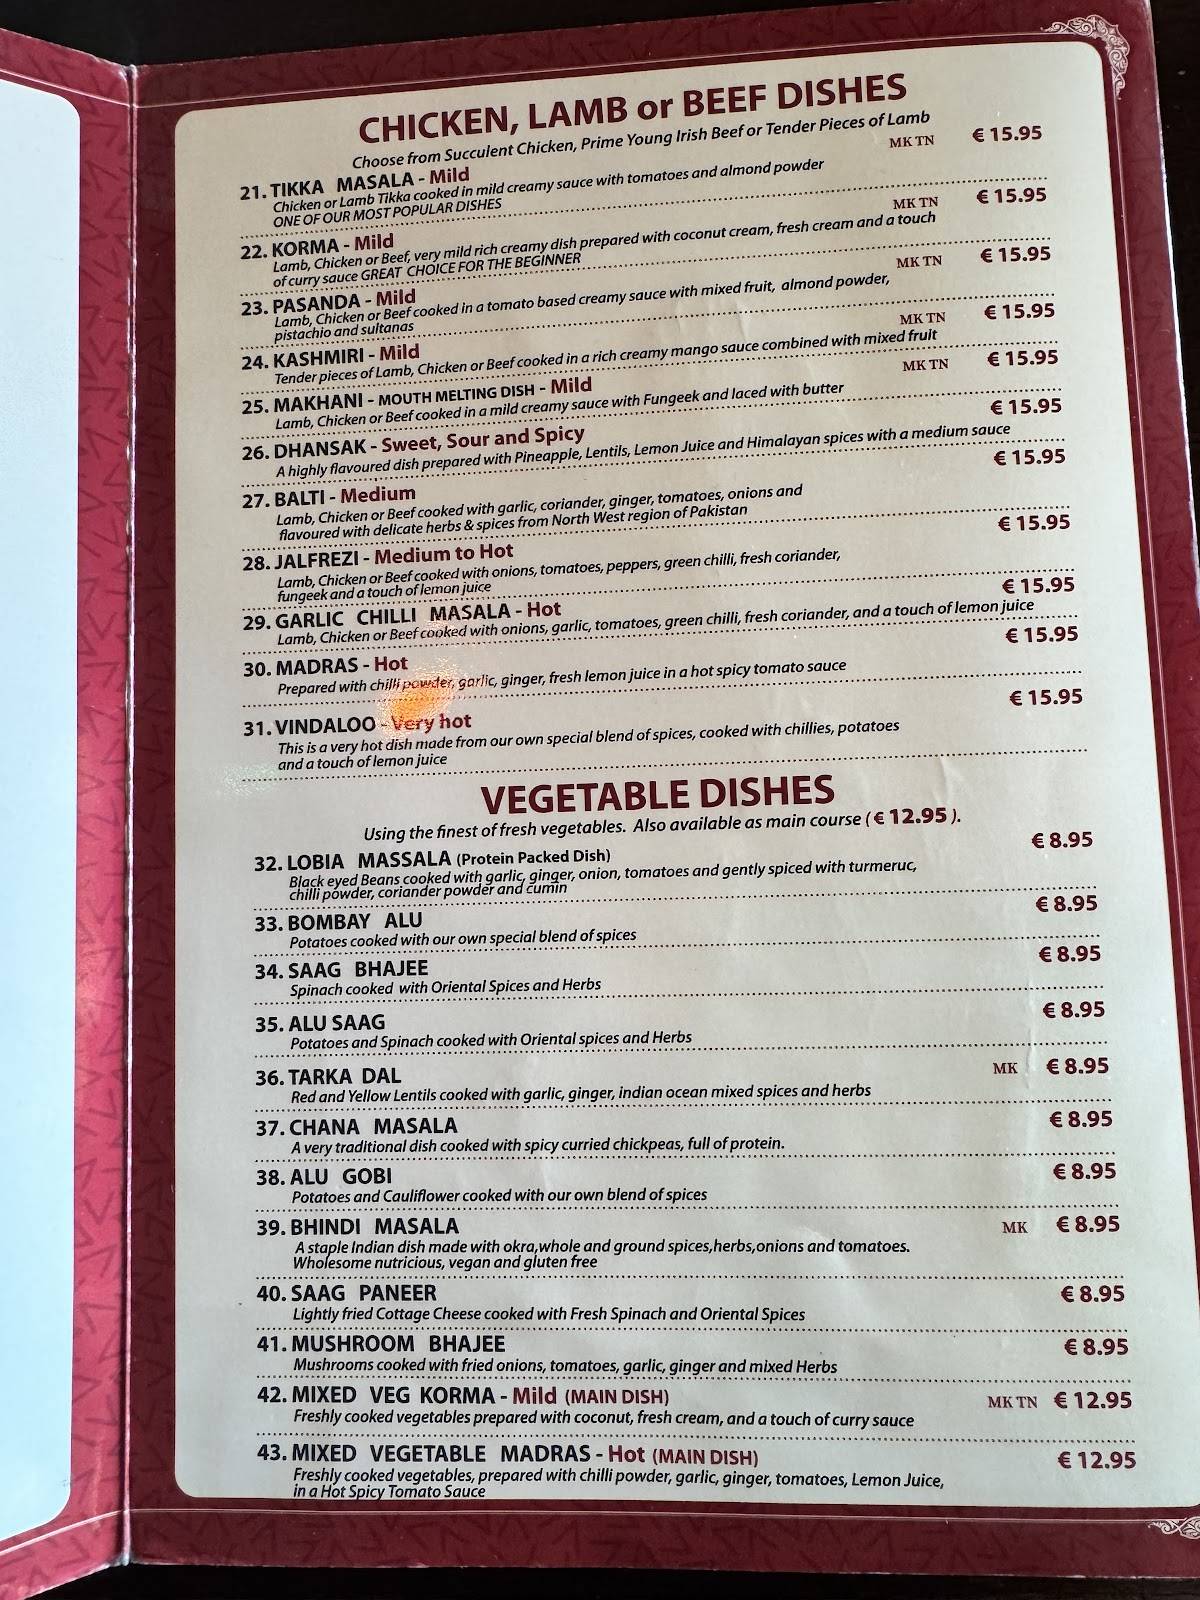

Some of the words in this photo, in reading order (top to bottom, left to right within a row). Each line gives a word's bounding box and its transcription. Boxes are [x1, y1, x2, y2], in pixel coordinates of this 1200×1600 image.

[359, 105, 519, 144] CHICKEN,
[529, 96, 628, 129] LAMB
[637, 98, 674, 120] or
[683, 84, 766, 117] BEEF
[777, 73, 907, 109] DISHES
[352, 155, 404, 169] Choose
[407, 151, 441, 165] from
[444, 144, 514, 162] Succulent
[516, 139, 577, 155] Chicken,
[581, 136, 624, 150] Prime
[627, 133, 673, 147] Young
[676, 127, 708, 143] Irish
[711, 124, 745, 140] Beef
[746, 126, 763, 137] or
[766, 119, 817, 135] Tender
[819, 117, 865, 131] Pieces
[868, 112, 886, 128] of
[887, 110, 930, 126] Lamb
[889, 136, 913, 148] MK
[915, 135, 934, 146] TN
[972, 128, 985, 143] €
[990, 125, 1042, 142] 15.95
[240, 185, 268, 201] 21.
[270, 179, 325, 198] TIKKA
[337, 172, 415, 193] MASALA
[429, 166, 470, 184] Mild
[273, 215, 301, 228] ONE
[303, 213, 321, 226] OF
[322, 210, 351, 224] OUR
[353, 207, 392, 221] MOST
[392, 201, 454, 218] POPULAR
[455, 197, 502, 212] DISHES
[240, 244, 268, 260] 22.
[272, 238, 340, 258] KORMA
[354, 232, 394, 251] Mild
[899, 313, 924, 325] MK
[925, 312, 946, 323] TN
[984, 305, 997, 320] €
[1002, 303, 1055, 319] 15.95
[241, 355, 269, 371] 24.
[273, 347, 364, 369] KASHMIRI
[379, 343, 420, 361] Mild
[242, 445, 270, 461] 26.
[274, 439, 367, 459] DHANSAK
[381, 436, 442, 453] Sweet,
[446, 433, 490, 449] Sour
[494, 427, 530, 446] and
[534, 425, 585, 446] Spicy
[275, 465, 285, 478] A
[288, 463, 328, 480] highly
[330, 459, 391, 475] flavoured
[393, 457, 419, 471] dish
[421, 453, 481, 472] prepared
[483, 451, 512, 465] with
[514, 447, 582, 465] Pineapple,
[585, 444, 631, 459] Lentils,
[634, 443, 679, 456] Lemon
[681, 439, 715, 453] Juice
[717, 436, 745, 450] and
[747, 434, 821, 449] Himalayan
[823, 431, 864, 447] spices
[867, 427, 897, 442] with
[899, 430, 909, 440] a
[911, 425, 968, 439] medium
[971, 425, 1011, 436] sauce
[242, 555, 271, 571] 28.
[274, 550, 359, 570] JALFREZI
[374, 547, 451, 565] Medium
[455, 546, 475, 561] to
[480, 543, 514, 559] Hot
[1002, 578, 1015, 594] €
[1020, 576, 1075, 594] 15.95
[243, 615, 271, 631] 29.
[275, 611, 344, 629] GARLIC
[356, 607, 416, 626] CHILLI
[430, 603, 511, 622] MASALA
[527, 601, 562, 618] Hot
[480, 779, 690, 815] VEGETABLE
[700, 774, 835, 808] DISHES
[1031, 832, 1045, 849] €
[1049, 831, 1093, 849] 8.95
[254, 856, 283, 872] 32.
[287, 853, 345, 871] LOBIA
[358, 850, 452, 869] MASSALA
[457, 852, 514, 868] (Protein
[518, 849, 570, 864] Packed
[573, 848, 611, 863] Dish)
[254, 916, 283, 932] 33.
[288, 913, 371, 931] BOMBAY
[384, 911, 422, 929] ALU
[289, 936, 348, 949] Potatoes
[350, 933, 399, 947] cooked
[400, 932, 430, 946] with
[432, 935, 456, 945] our
[458, 935, 487, 945] own
[489, 930, 537, 947] special
[539, 929, 577, 943] blend
[580, 928, 596, 942] of
[596, 928, 637, 945] spices
[255, 964, 284, 980] 34.
[288, 961, 341, 979] SAAG
[355, 959, 429, 977] BHAJEE
[290, 982, 343, 1000] Spinach
[345, 981, 394, 995] cooked
[399, 980, 428, 994] with
[431, 979, 487, 994] Oriental
[488, 979, 530, 996] Spices
[532, 978, 560, 992] and
[562, 977, 601, 991] Herbs
[255, 1070, 285, 1086] 36.
[288, 1068, 353, 1085] TARKA
[362, 1067, 402, 1084] DAL
[992, 1062, 1018, 1075] MK
[1046, 1058, 1060, 1075] €
[1064, 1057, 1109, 1075] 8.95
[257, 1219, 286, 1236] 39.
[291, 1218, 360, 1236] BHINDI
[375, 1217, 460, 1235] MASALA
[256, 1285, 287, 1302] 40.
[291, 1284, 345, 1302] SAAG
[359, 1284, 437, 1302] PANEER
[293, 1306, 340, 1324] Lightly
[342, 1306, 374, 1320] fried
[376, 1307, 430, 1324] Cottage
[433, 1306, 482, 1320] Cheese
[484, 1306, 535, 1320] cooked
[537, 1306, 567, 1320] with
[570, 1306, 607, 1320] Fresh
[610, 1306, 666, 1324] Spinach
[669, 1306, 698, 1321] and
[700, 1306, 759, 1321] Oriental
[761, 1307, 806, 1325] Spices
[257, 1336, 287, 1352] 41.
[291, 1334, 415, 1352] MUSHROOM
[429, 1335, 506, 1353] BHAJEE
[257, 1386, 287, 1403] 42.
[292, 1385, 357, 1403] MIXED
[369, 1386, 410, 1404] VEG
[420, 1386, 496, 1404] KORMA
[512, 1386, 557, 1405] Mild
[565, 1389, 617, 1406] (MAIN
[622, 1389, 669, 1407] DISH)
[987, 1396, 1013, 1408] MK
[1015, 1396, 1037, 1409] TN
[1053, 1391, 1068, 1409] €
[1074, 1391, 1132, 1409] 12.95
